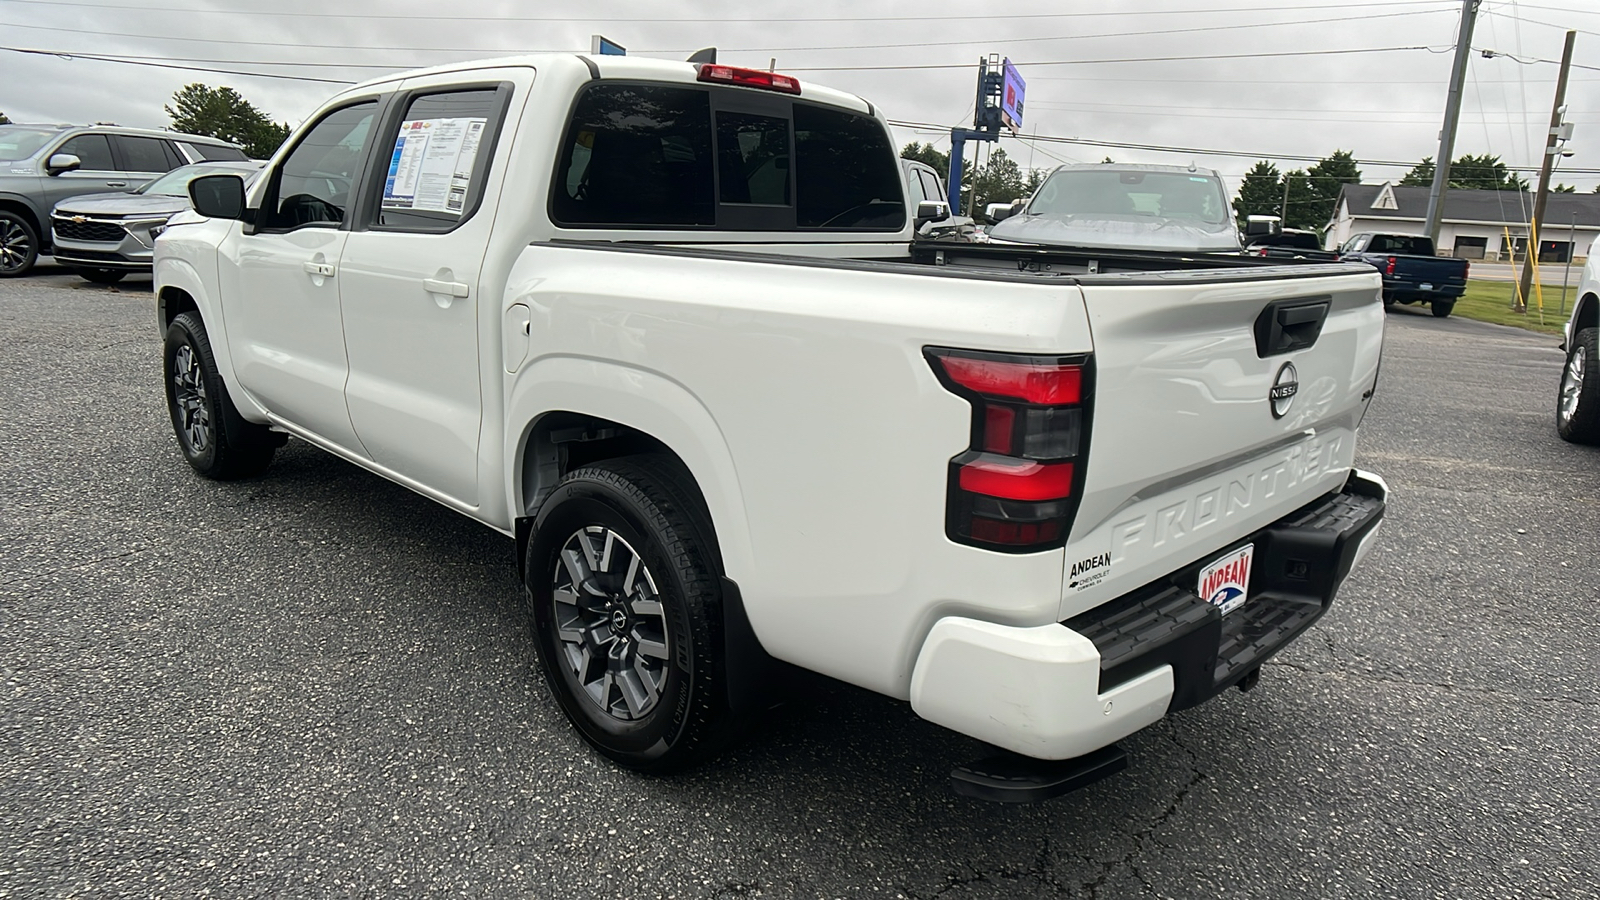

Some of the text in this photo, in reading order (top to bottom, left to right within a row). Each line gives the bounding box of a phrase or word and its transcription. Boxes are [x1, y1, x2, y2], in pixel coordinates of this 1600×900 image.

[1271, 385, 1297, 398] NISS
[1110, 437, 1342, 563] FRONTIER
[1069, 551, 1112, 580] ANDEAN
[1079, 569, 1110, 586] CHEVROLET
[1201, 555, 1249, 601] ANDEAN
